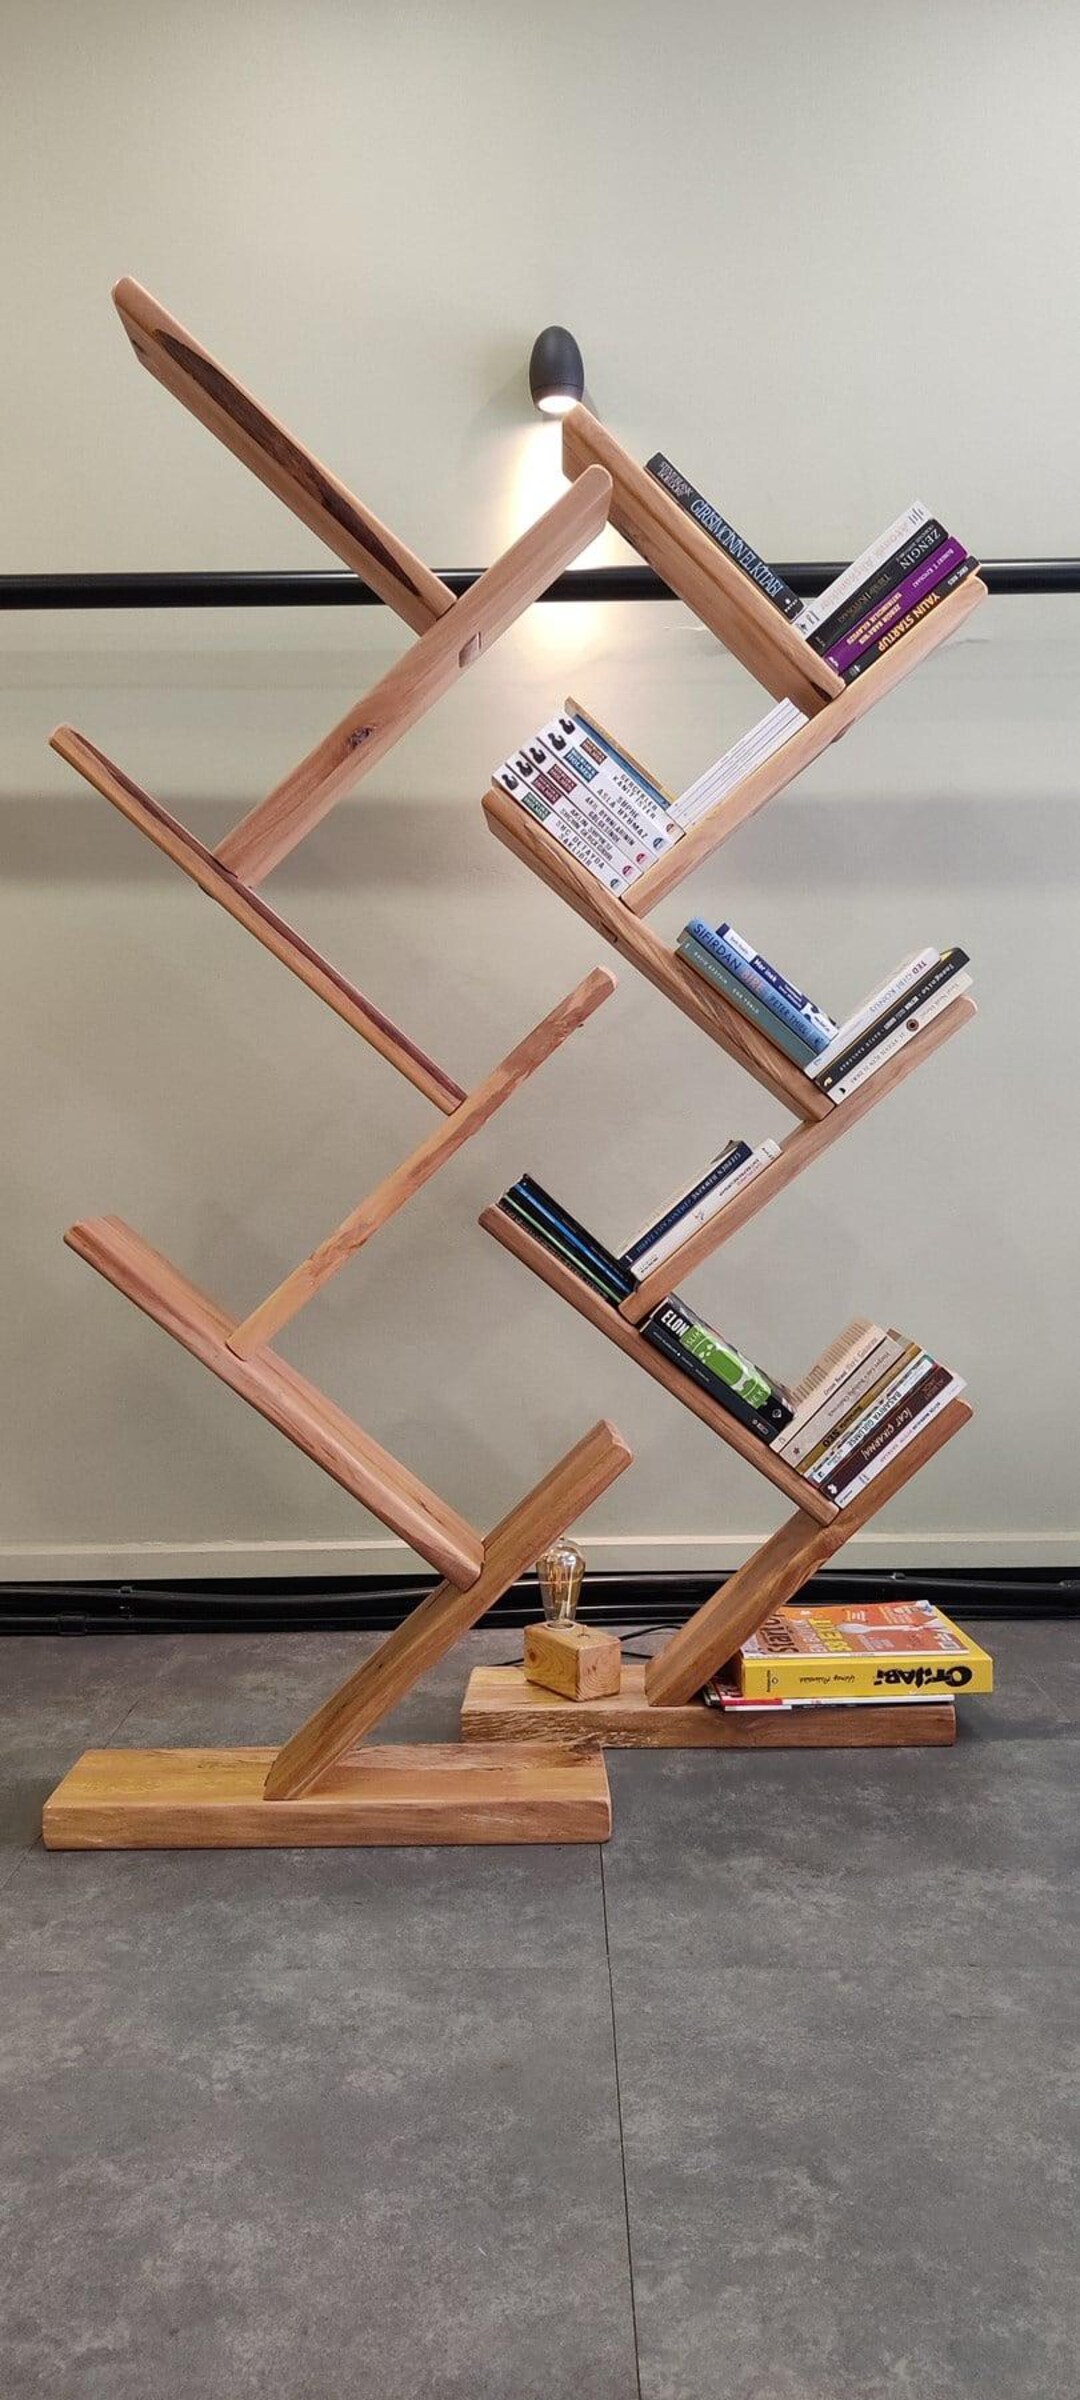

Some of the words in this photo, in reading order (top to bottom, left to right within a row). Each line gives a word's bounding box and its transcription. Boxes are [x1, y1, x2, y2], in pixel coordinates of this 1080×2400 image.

[739, 550, 759, 570] EL
[898, 528, 942, 571] ZENGİN
[910, 590, 940, 618] YALIN
[874, 613, 915, 652] STARTUP
[692, 922, 743, 970] SIFIRDAN
[910, 959, 927, 975] TED
[659, 1308, 690, 1337] ELON
[820, 1427, 841, 1448] SEO
